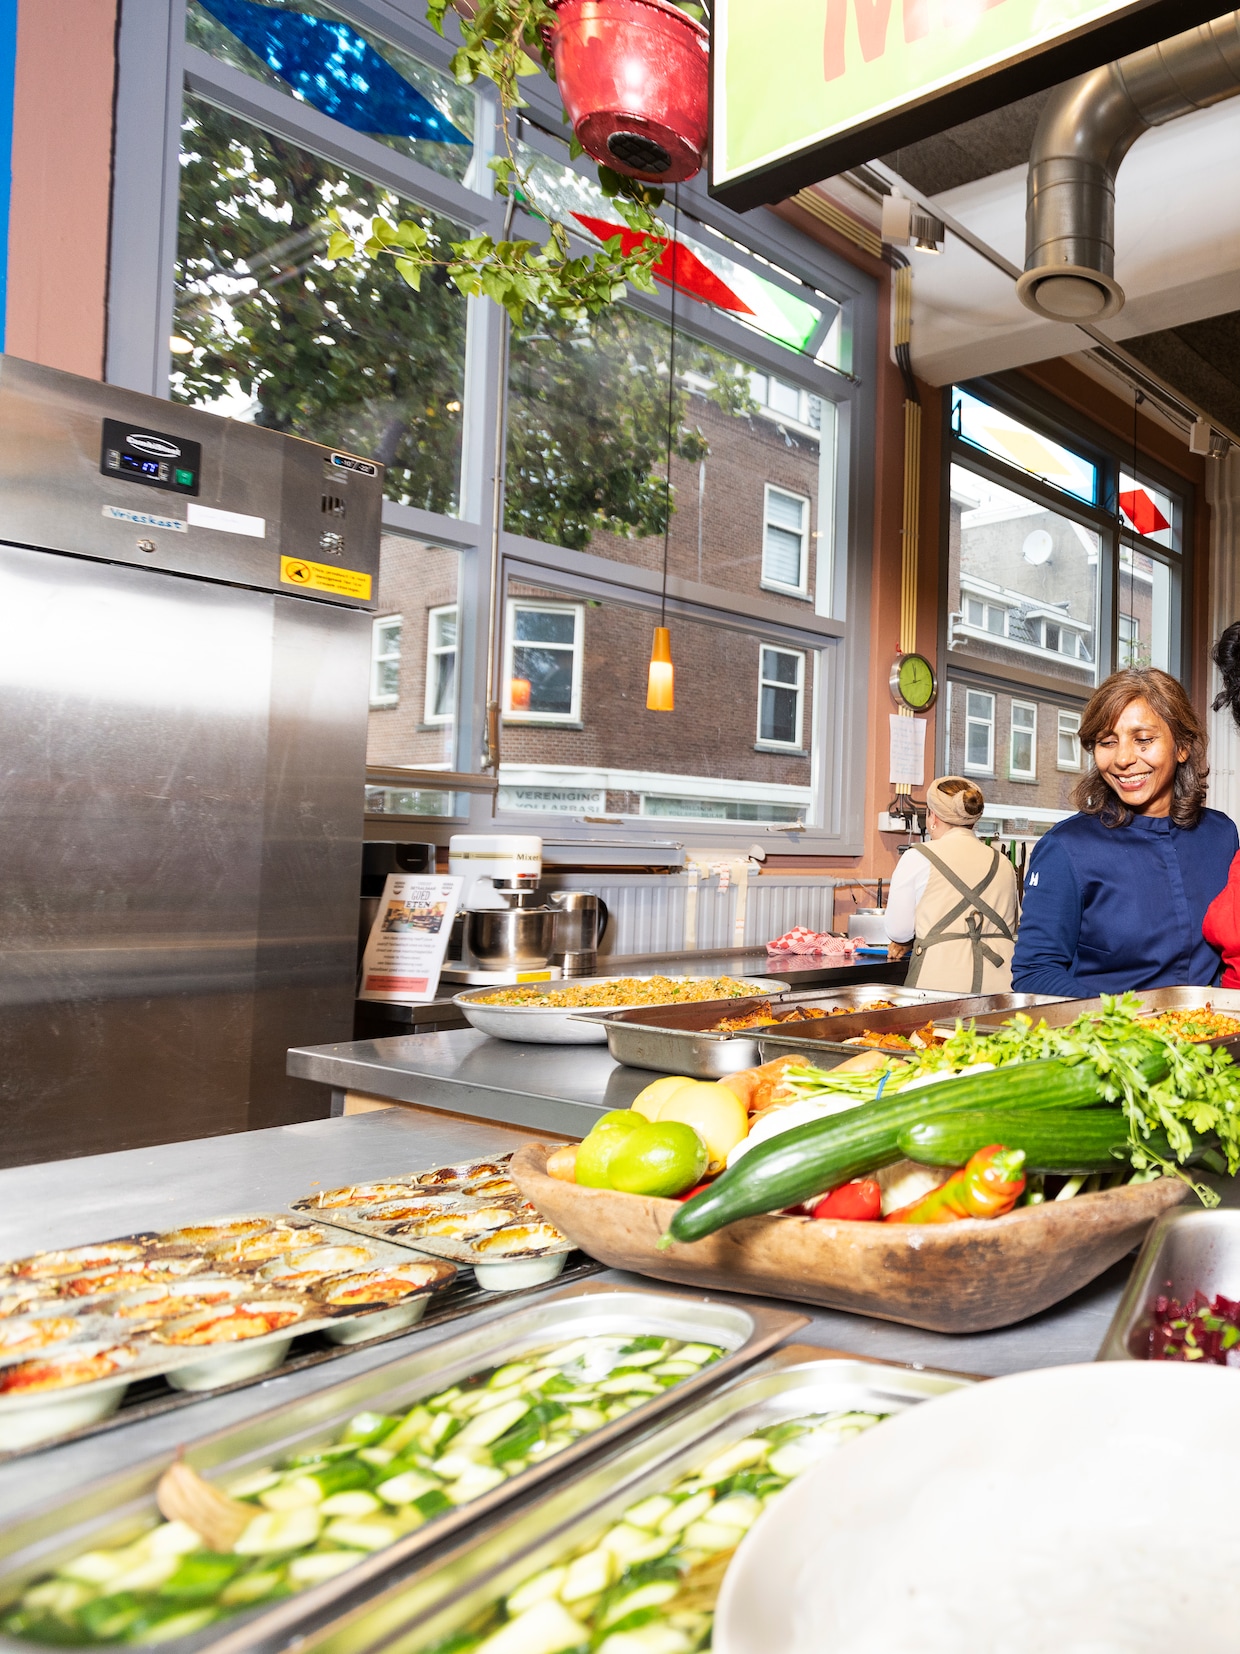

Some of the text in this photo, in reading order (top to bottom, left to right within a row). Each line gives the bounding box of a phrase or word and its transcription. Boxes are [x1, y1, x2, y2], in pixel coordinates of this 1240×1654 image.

[516, 791, 600, 802] VERENIGING
[411, 890, 431, 901] GOED
[406, 901, 431, 909] ETEN
